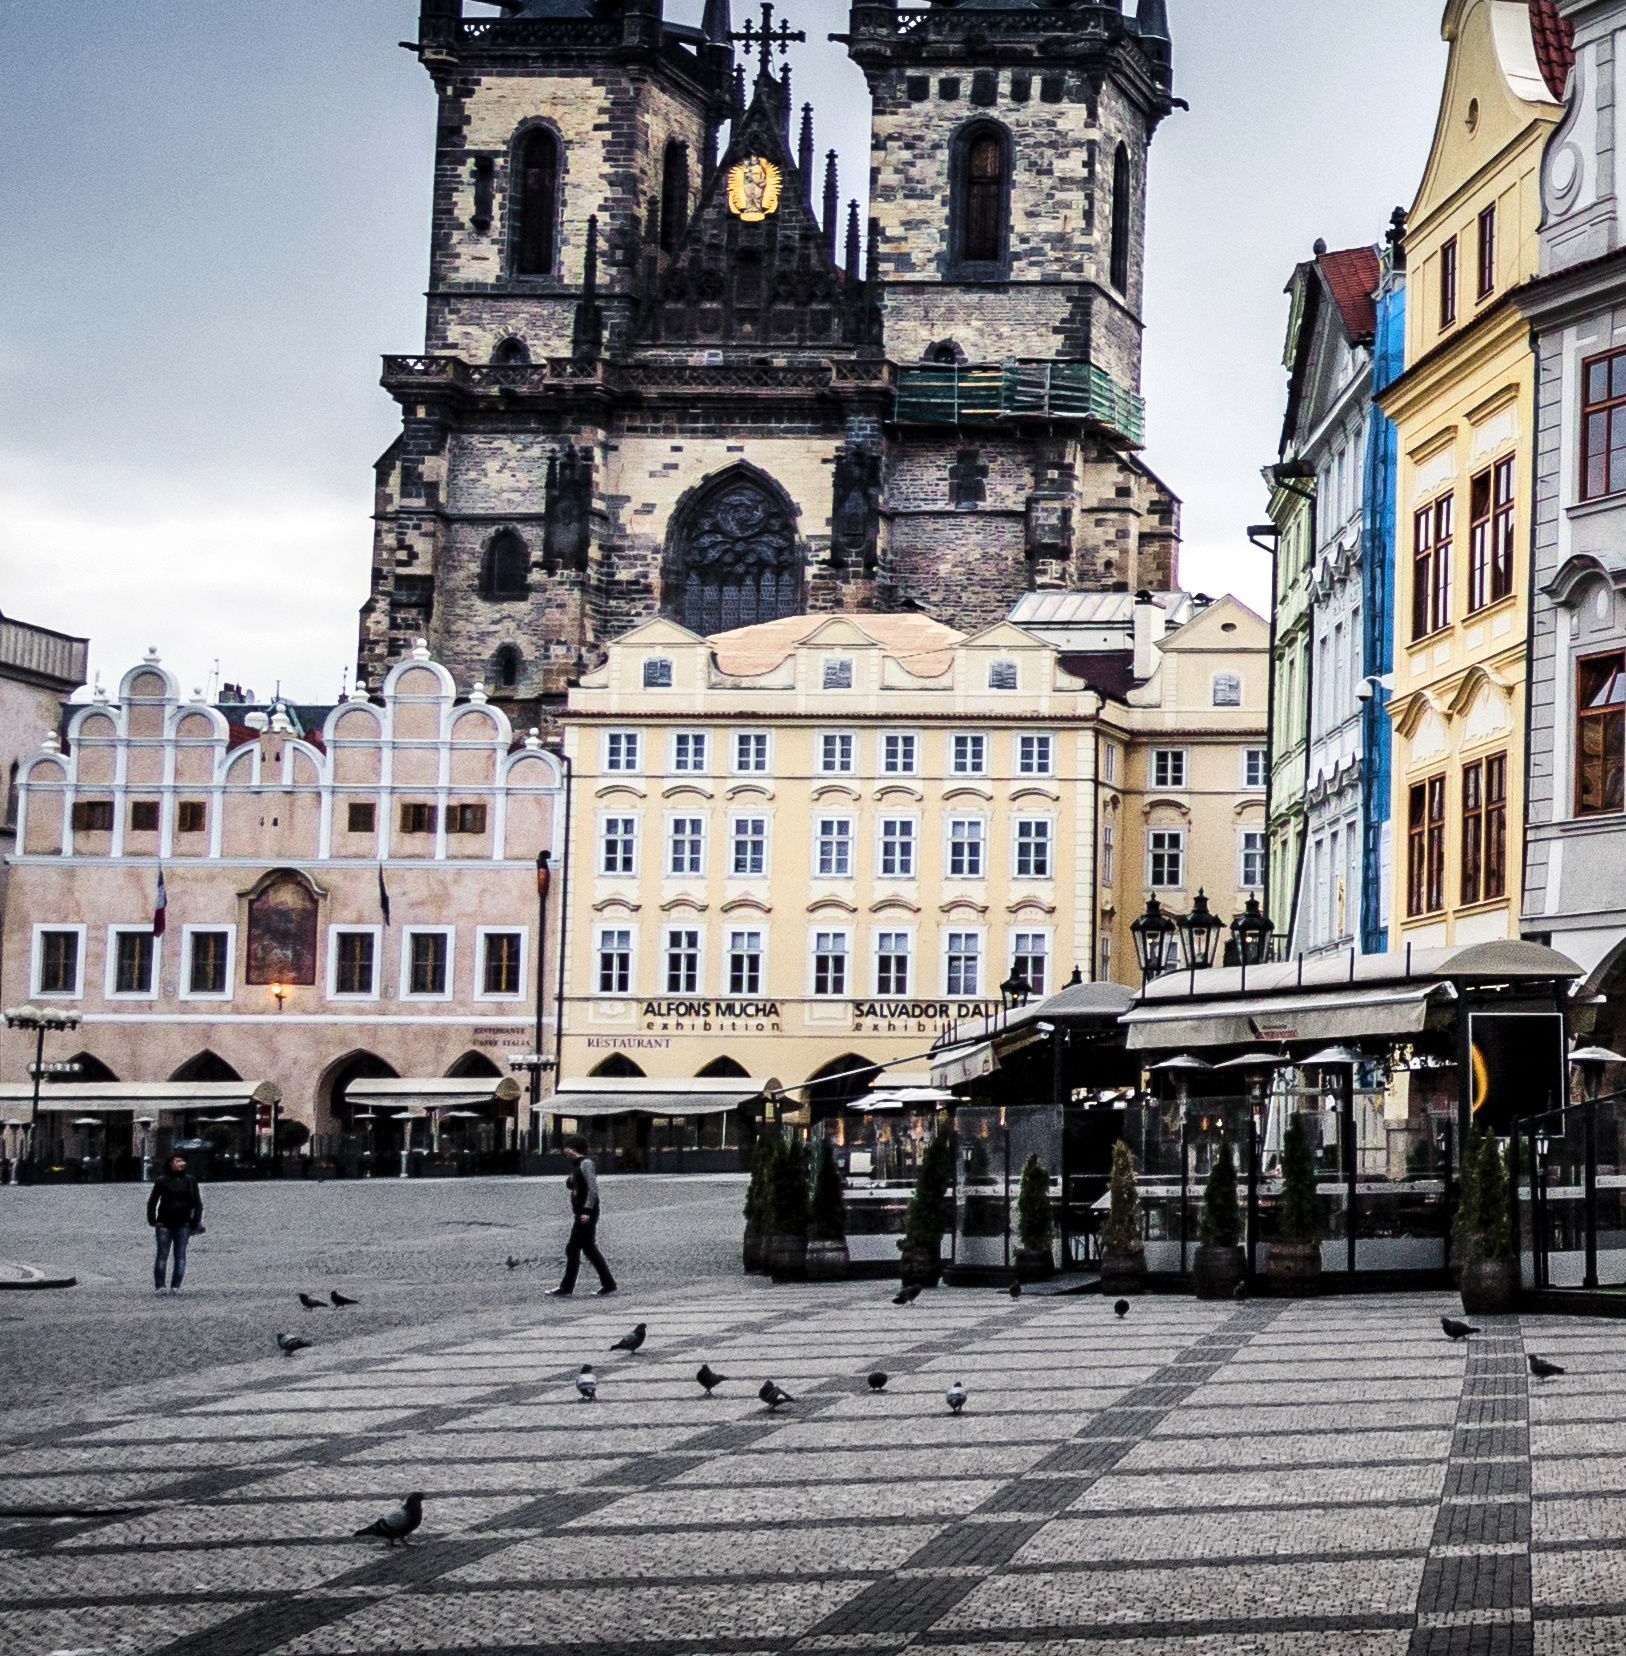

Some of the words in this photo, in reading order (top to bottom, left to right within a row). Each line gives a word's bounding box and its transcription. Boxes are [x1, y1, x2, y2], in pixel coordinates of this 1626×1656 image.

[643, 1001, 711, 1017] ALFONS
[715, 1001, 780, 1018] MUCHA
[854, 1002, 950, 1018] SALVADOR
[646, 1019, 780, 1032] exhibition
[586, 1037, 671, 1049] RESTAURANT
